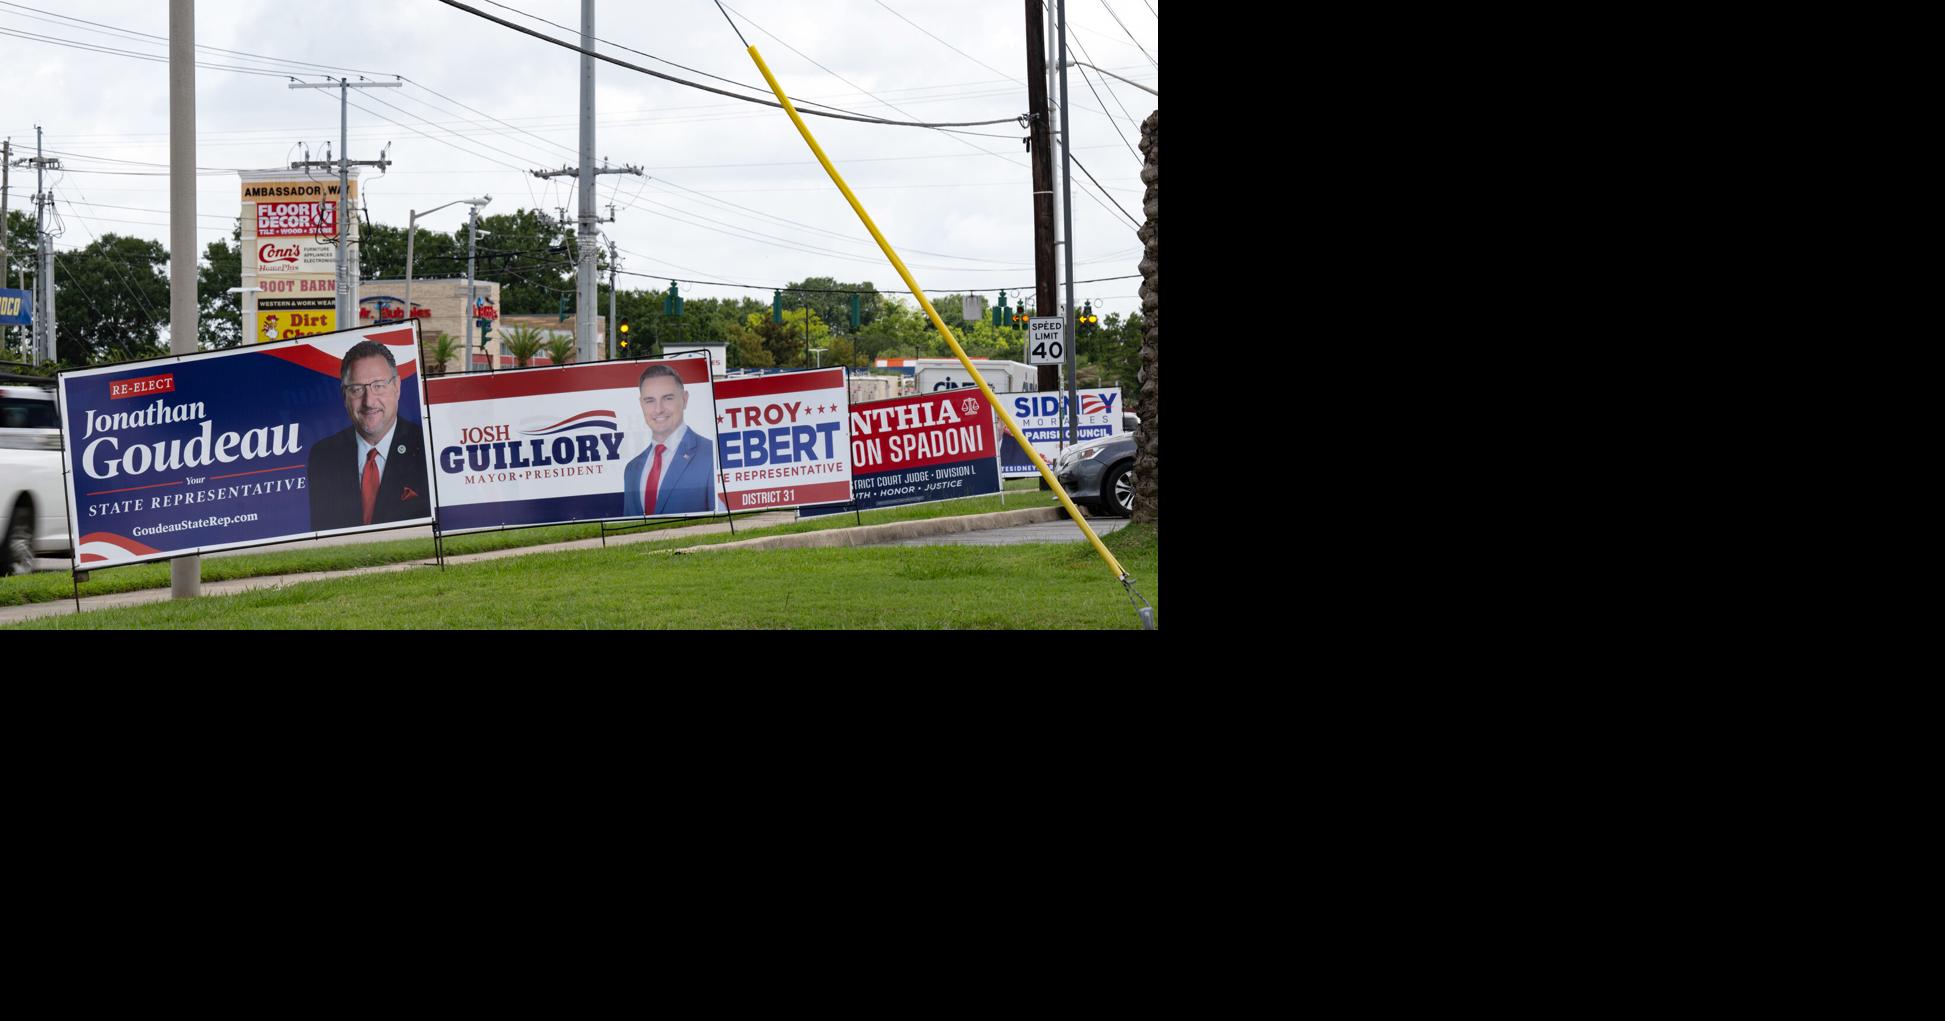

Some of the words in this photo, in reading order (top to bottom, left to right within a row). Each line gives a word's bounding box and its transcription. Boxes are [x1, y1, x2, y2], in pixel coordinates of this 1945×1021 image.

[244, 185, 321, 197] AMBASSADOR
[258, 203, 310, 216] FLOOR
[258, 215, 310, 228] DECOR
[258, 243, 300, 263] Conn's
[260, 280, 295, 292] BOOT
[300, 279, 336, 292] BARN
[0, 296, 21, 316] OCO
[290, 313, 328, 326] Dirt
[1032, 322, 1062, 330] SPEED
[1035, 332, 1058, 340] LIMIT
[1032, 341, 1063, 358] 40
[112, 378, 173, 396] RE-ELECT
[82, 399, 206, 440] Jonathan
[725, 401, 802, 429] TROY
[850, 399, 961, 436] NTHIA
[460, 424, 511, 445] JOSH
[1065, 428, 1110, 439] CUNCIL
[82, 420, 302, 480] Goudeau
[440, 432, 625, 474] GUILLORY
[718, 421, 841, 469] EBERT
[852, 438, 883, 467] ON
[888, 424, 984, 463] SPADONI
[186, 476, 206, 485] Your
[735, 462, 843, 482] REPRESENTATIVE
[854, 477, 875, 490] TRICT
[877, 474, 902, 487] COURT
[905, 471, 929, 483] JUDGE
[936, 465, 971, 480] DIVISION
[971, 465, 976, 475] L
[89, 499, 144, 517] STATE
[151, 477, 306, 510] REPRESENTATIVE
[742, 490, 781, 506] DISTRICT
[783, 489, 795, 502] 31
[880, 486, 915, 496] HONOR
[924, 480, 963, 491] JUSTICE
[132, 512, 258, 537] GoudeauStateRep.com
